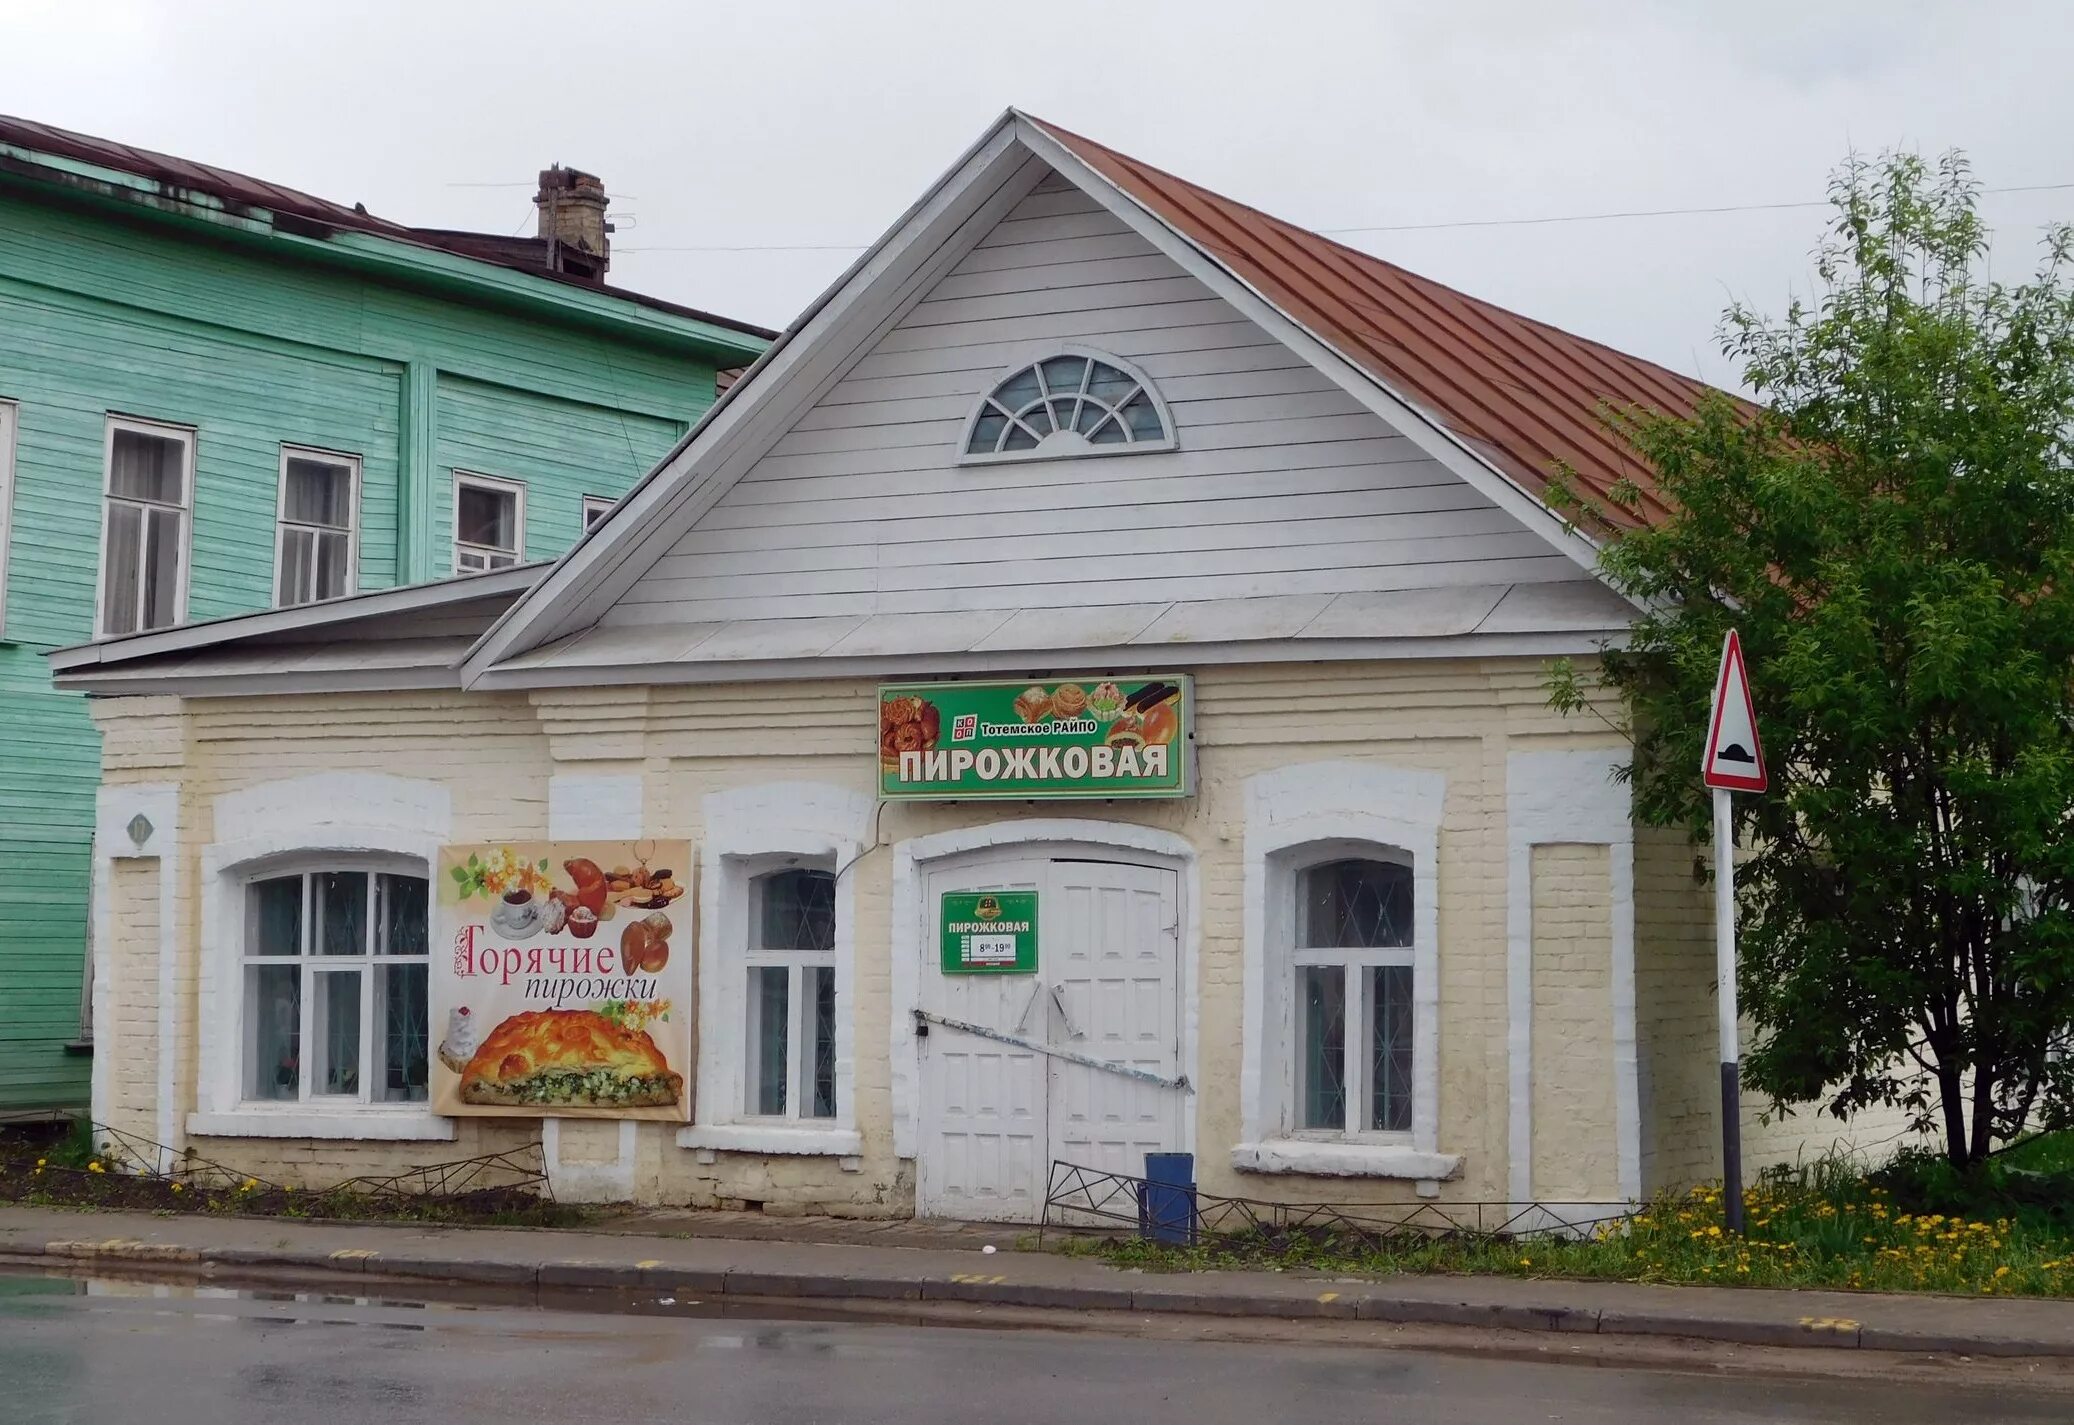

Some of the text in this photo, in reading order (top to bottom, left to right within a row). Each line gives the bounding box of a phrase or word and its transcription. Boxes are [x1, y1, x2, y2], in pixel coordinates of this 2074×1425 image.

[982, 717, 1096, 735] Тотемское РАЙПО
[899, 744, 1168, 783] ПИРОЖКОВАЯ
[948, 922, 1029, 933] ПИРОЖКОВАЯ
[454, 924, 615, 986] Горячие
[524, 976, 657, 1008] пирожки
